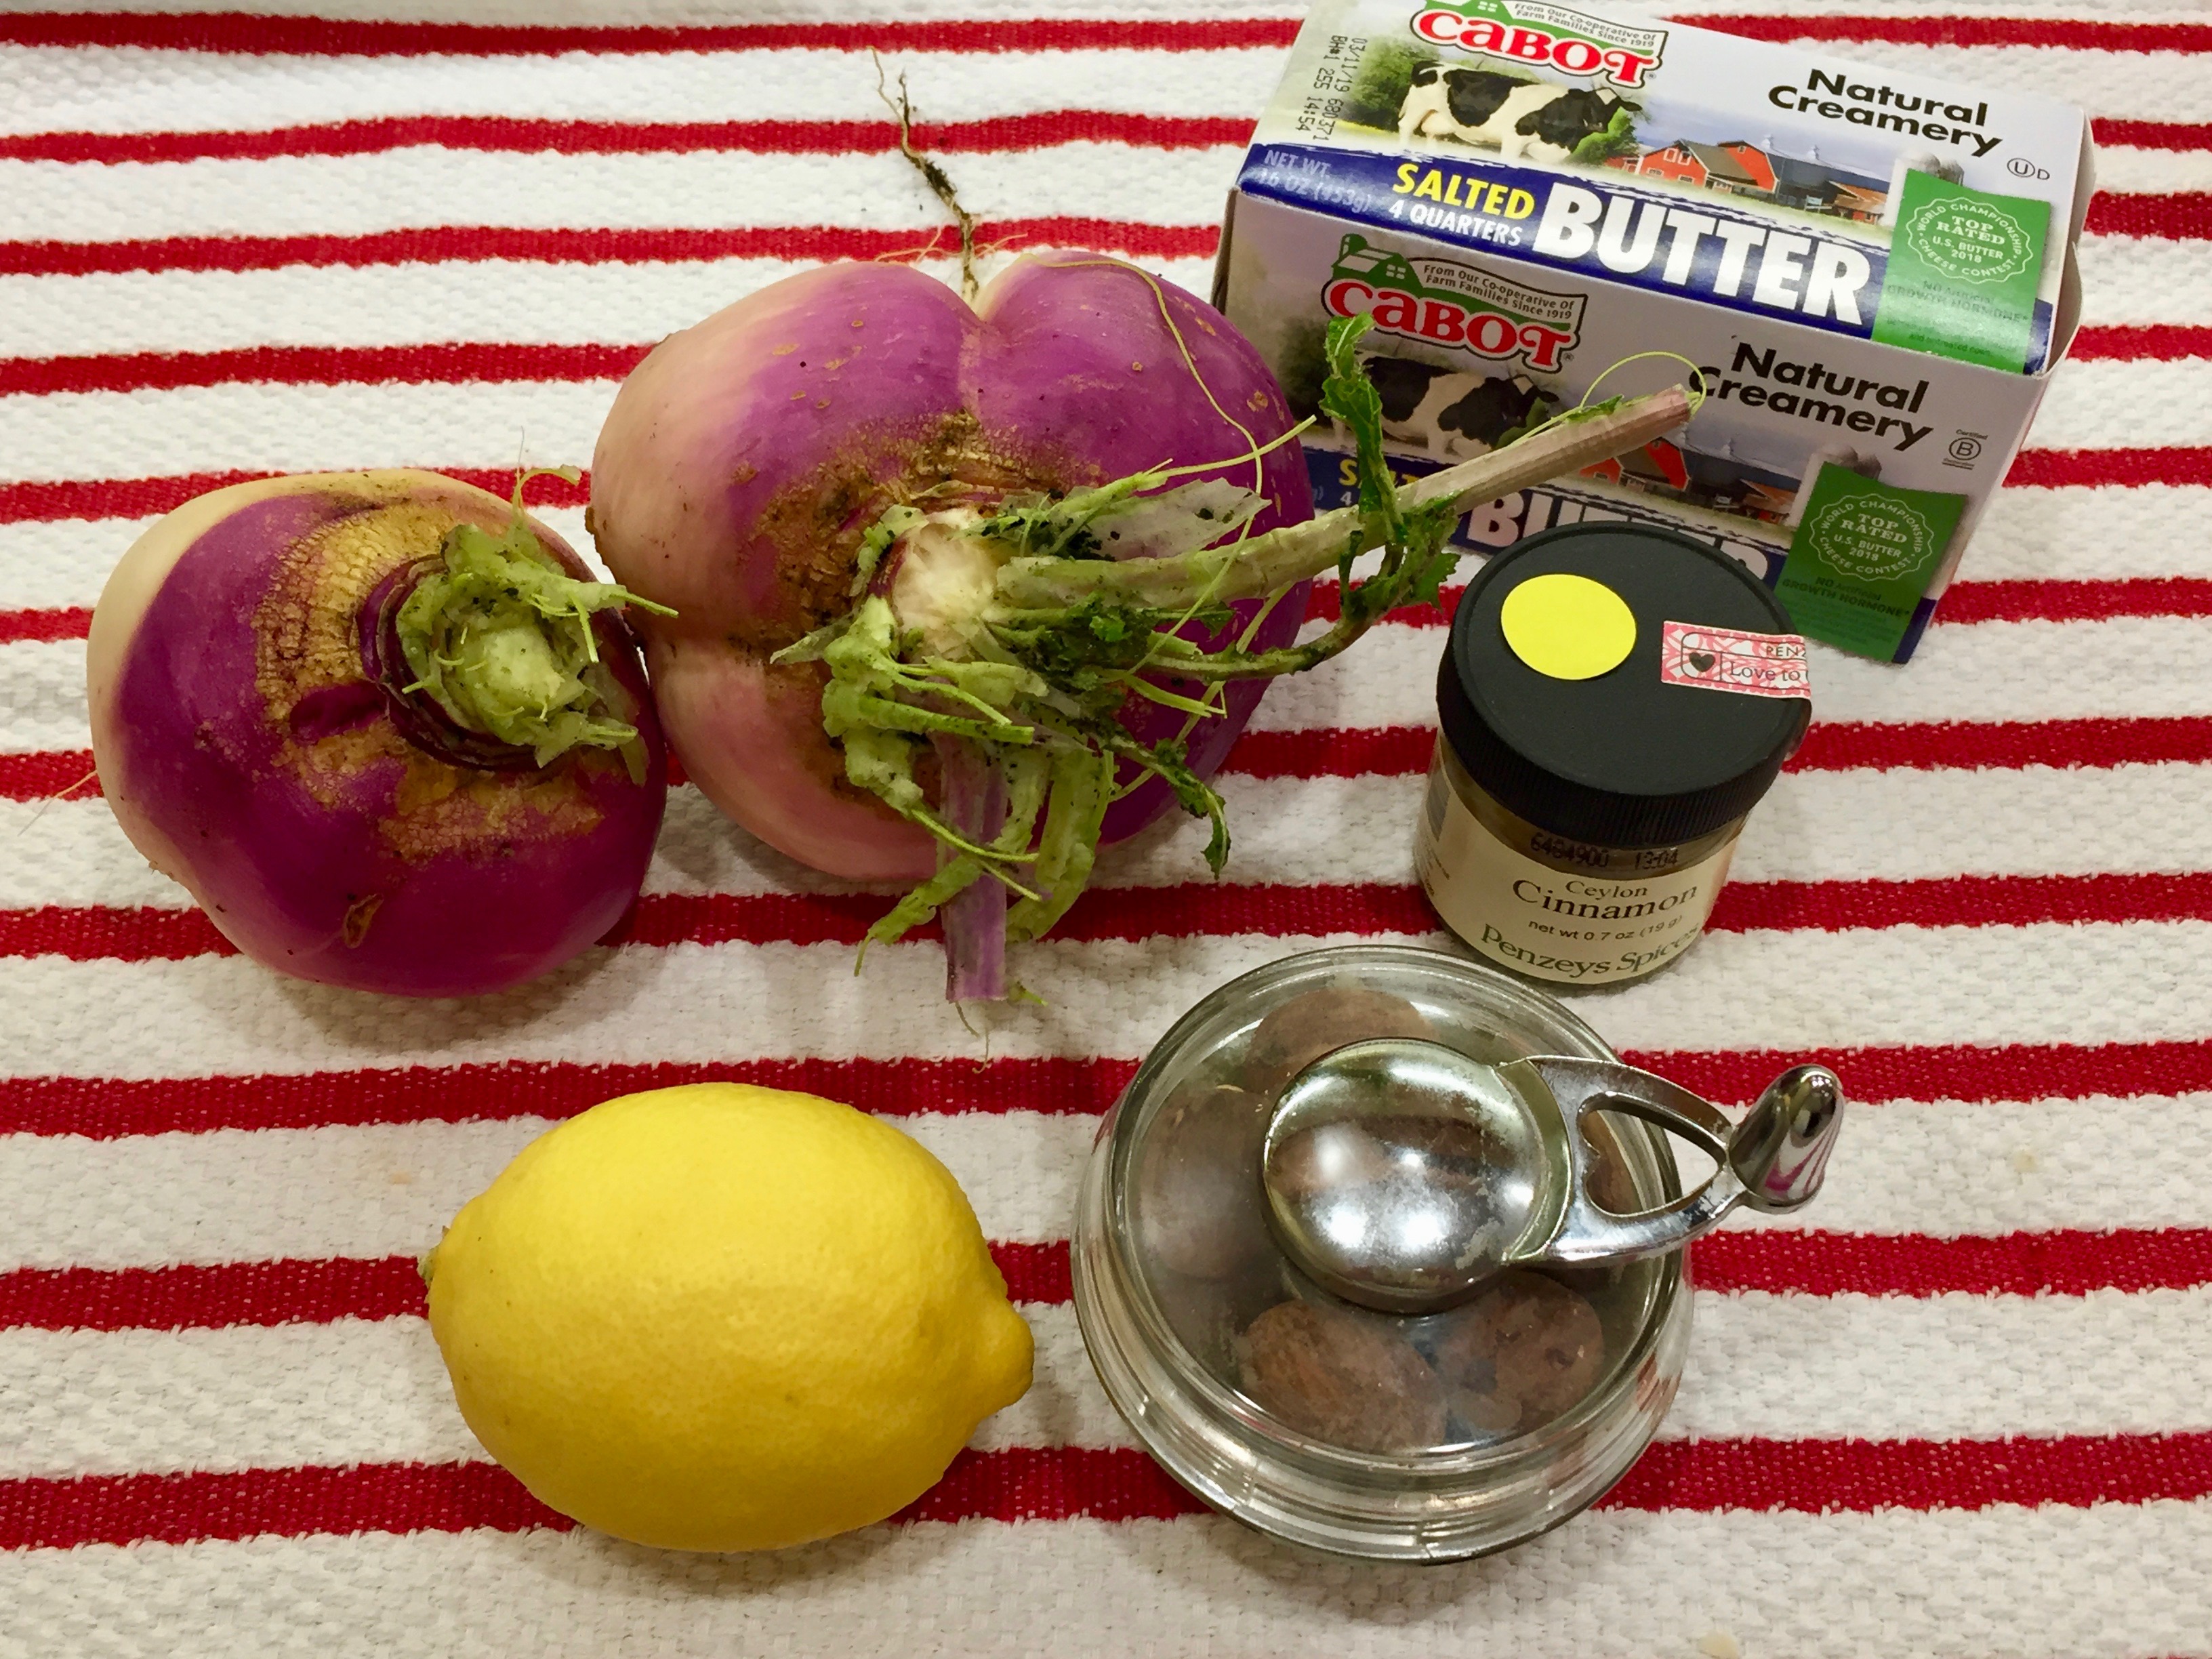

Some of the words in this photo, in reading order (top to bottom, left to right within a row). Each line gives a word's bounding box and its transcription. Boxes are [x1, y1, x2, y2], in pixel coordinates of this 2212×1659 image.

[1515, 3, 1544, 12] From
[1548, 9, 1567, 18] Our
[1570, 14, 1640, 38] Co-operative
[1516, 10, 1544, 19] Farm
[1548, 16, 1594, 34] Families
[1597, 30, 1627, 43] Since
[1313, 67, 1335, 90] 255
[1334, 38, 1368, 93] 03/11/19
[1295, 96, 1324, 131] 14:54
[1807, 68, 1988, 126] Natural
[1768, 85, 2003, 157] Creamery
[1265, 150, 1298, 169] NET
[1258, 168, 1279, 187] 16
[1285, 175, 1311, 194] OZ
[1393, 163, 1535, 219] SALTED
[1389, 200, 1404, 218] 4
[1410, 204, 1523, 247] QUARTERS
[1917, 205, 1946, 231] WORLD
[1950, 203, 2022, 255] CHAMPIONSHIP
[1936, 222, 2005, 245] RATED
[1952, 216, 1993, 232] TOP
[1532, 182, 1870, 325] BUTTER
[1919, 239, 1957, 271] CHEESE
[1961, 258, 2015, 276] CONTEST
[1933, 236, 1954, 248] U.S.
[1959, 242, 2004, 260] BUTTER
[1951, 249, 1982, 263] 2018
[1424, 264, 1455, 277] From
[1458, 270, 1479, 284] Our
[1482, 279, 1557, 309] Co-operative
[1559, 300, 1575, 310] Of
[1426, 274, 1456, 287] Farm
[1459, 281, 1509, 305] Families
[1511, 299, 1543, 316] Since
[1547, 310, 1572, 320] 1919
[1731, 342, 1929, 413] Natural
[1689, 366, 1934, 452] Creamery
[1340, 491, 1353, 506] 4
[1821, 503, 1854, 529] WORLD
[1860, 500, 1923, 553] CHAMPIONSHIP
[1840, 519, 1907, 543] RATED
[1858, 513, 1898, 529] TOP
[1820, 537, 1853, 569] CHEESE
[1856, 557, 1911, 574] CONTEST
[1849, 547, 1879, 562] 2018
[1858, 540, 1902, 558] BUTTER
[1782, 578, 1837, 598] GROWTH
[1816, 577, 1834, 587] NO
[1729, 661, 1776, 681] Love
[1782, 669, 1801, 682] to
[1513, 880, 1698, 919] Cinnamon
[1565, 881, 1648, 900] Ceylon
[1528, 920, 1554, 935] net
[1559, 927, 1579, 939] wt
[1584, 932, 1610, 941] 0.7
[1615, 930, 1635, 939] oz
[1481, 924, 1611, 978] Penzeys
[1616, 923, 1700, 972] Spices
